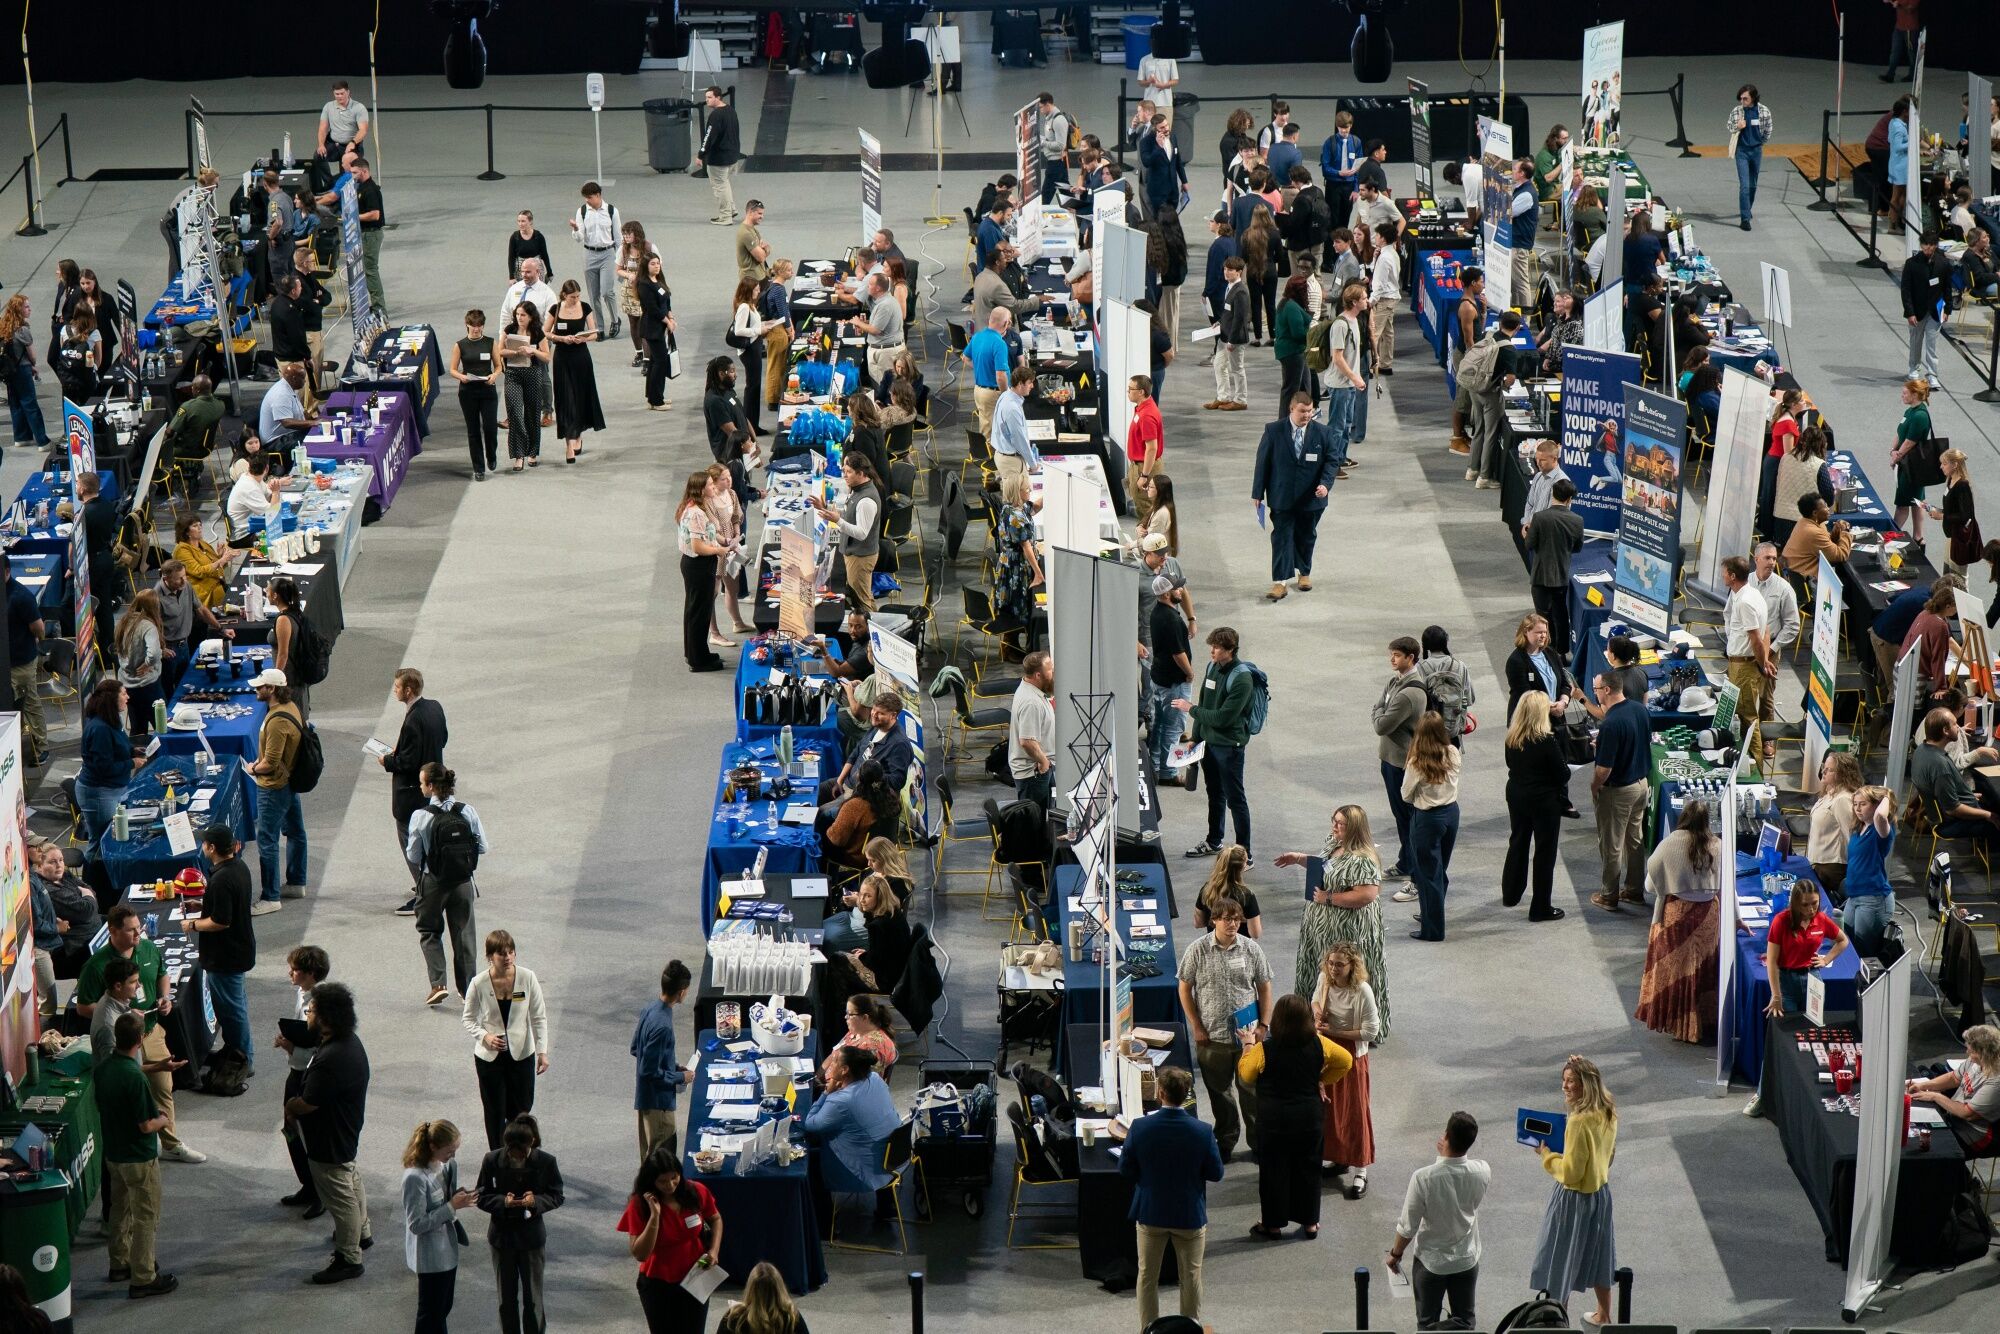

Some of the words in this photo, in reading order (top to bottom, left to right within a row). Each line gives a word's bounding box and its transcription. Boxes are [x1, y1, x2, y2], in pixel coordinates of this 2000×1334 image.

[1566, 377, 1599, 396] MAKE
[1565, 396, 1581, 411] AN
[1584, 398, 1626, 419] IMPACT
[70, 420, 90, 441] LENOIR
[1565, 413, 1597, 432] YOUR
[1564, 432, 1592, 449] OWN
[1563, 449, 1592, 467] WAY.
[1591, 502, 1618, 511] actuaries
[1622, 508, 1669, 532] CAREERS.PULTE.COM
[1626, 522, 1638, 532] Build
[1638, 526, 1647, 536] Your
